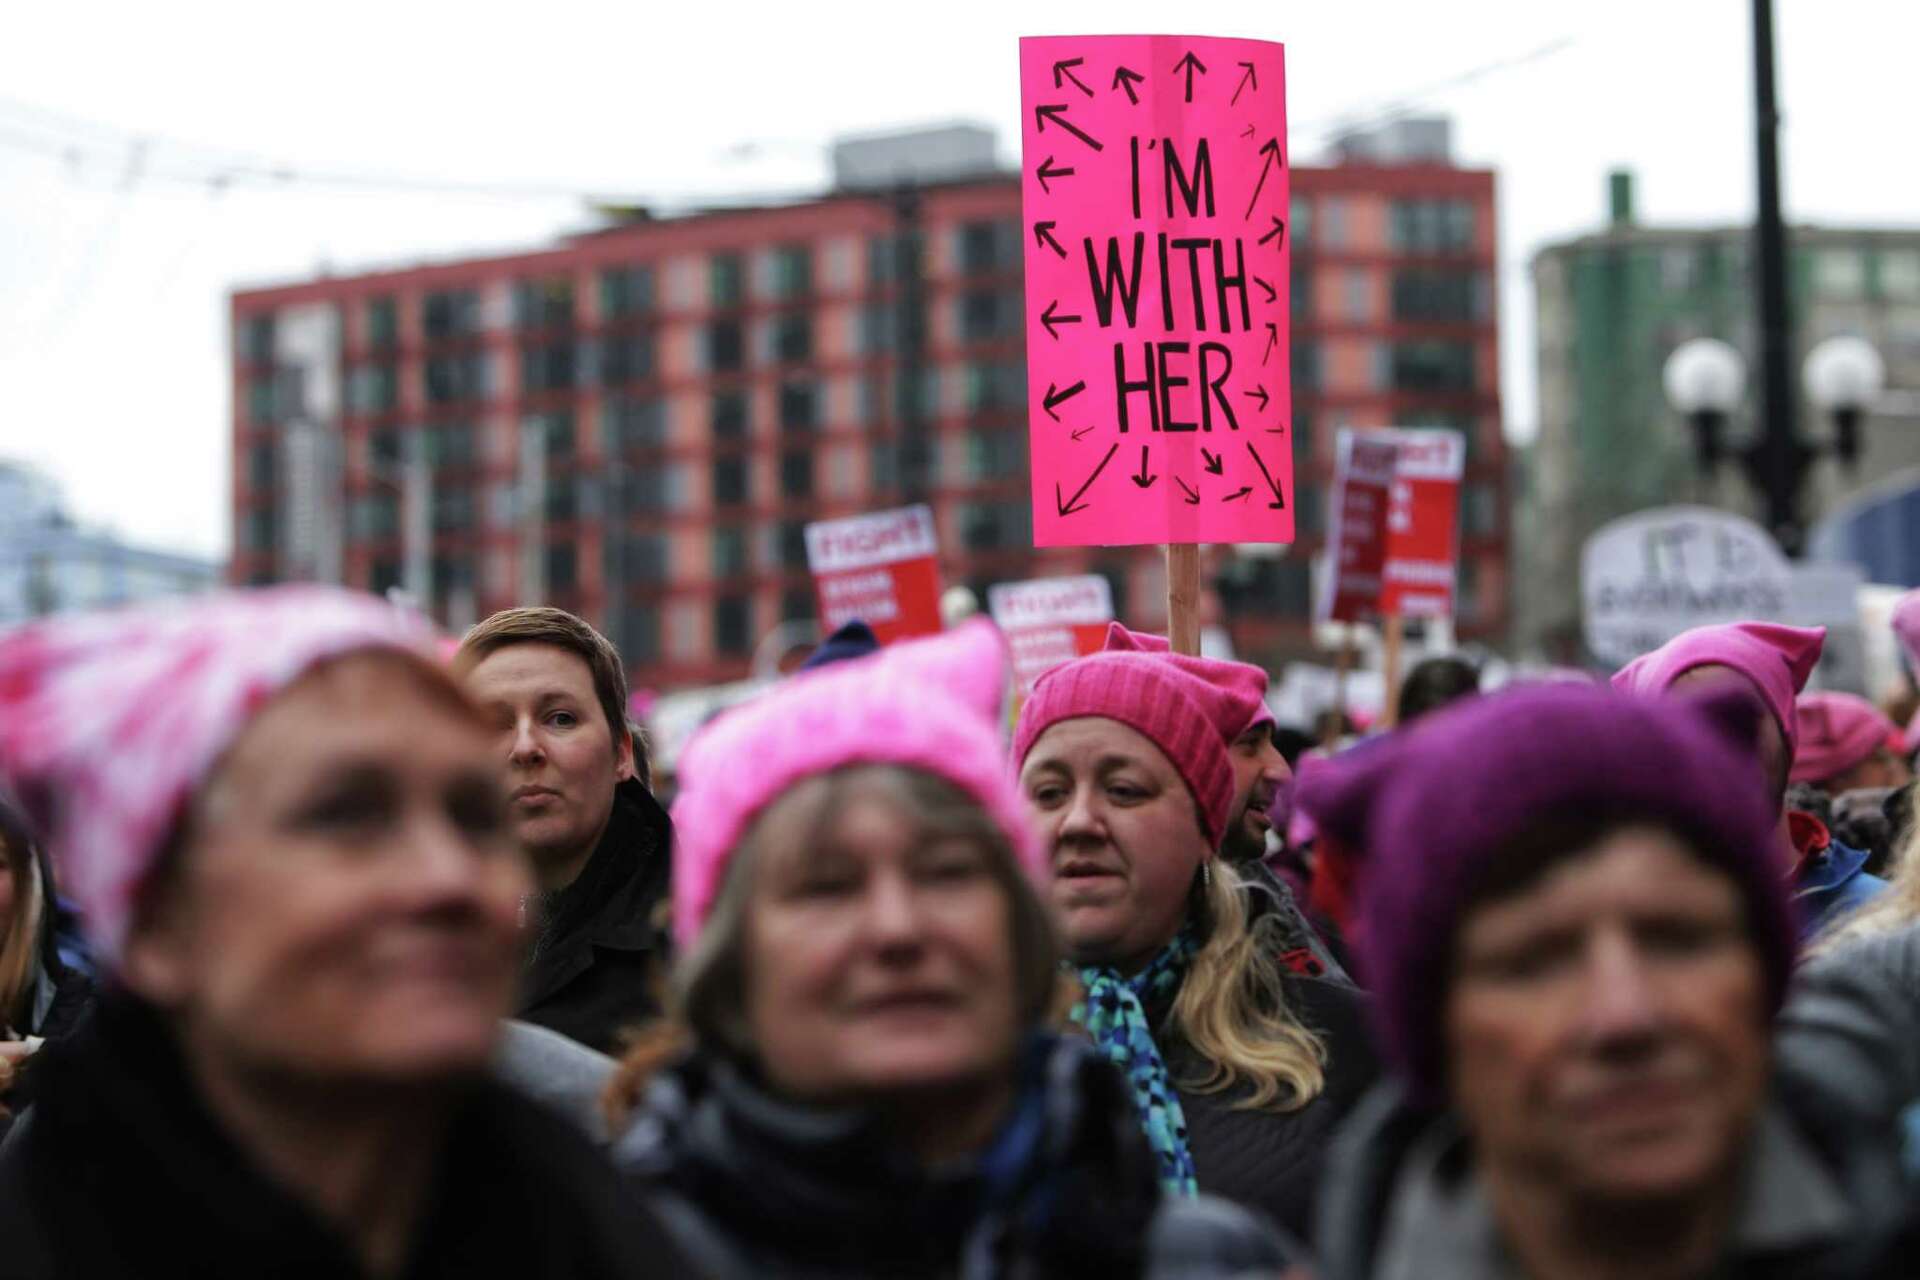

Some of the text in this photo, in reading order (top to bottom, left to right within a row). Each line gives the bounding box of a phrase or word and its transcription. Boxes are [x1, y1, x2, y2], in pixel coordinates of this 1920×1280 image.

[1130, 136, 1216, 219] I'M
[1083, 231, 1251, 333] WITH
[1114, 341, 1239, 433] HER
[819, 512, 920, 557] FIGHT
